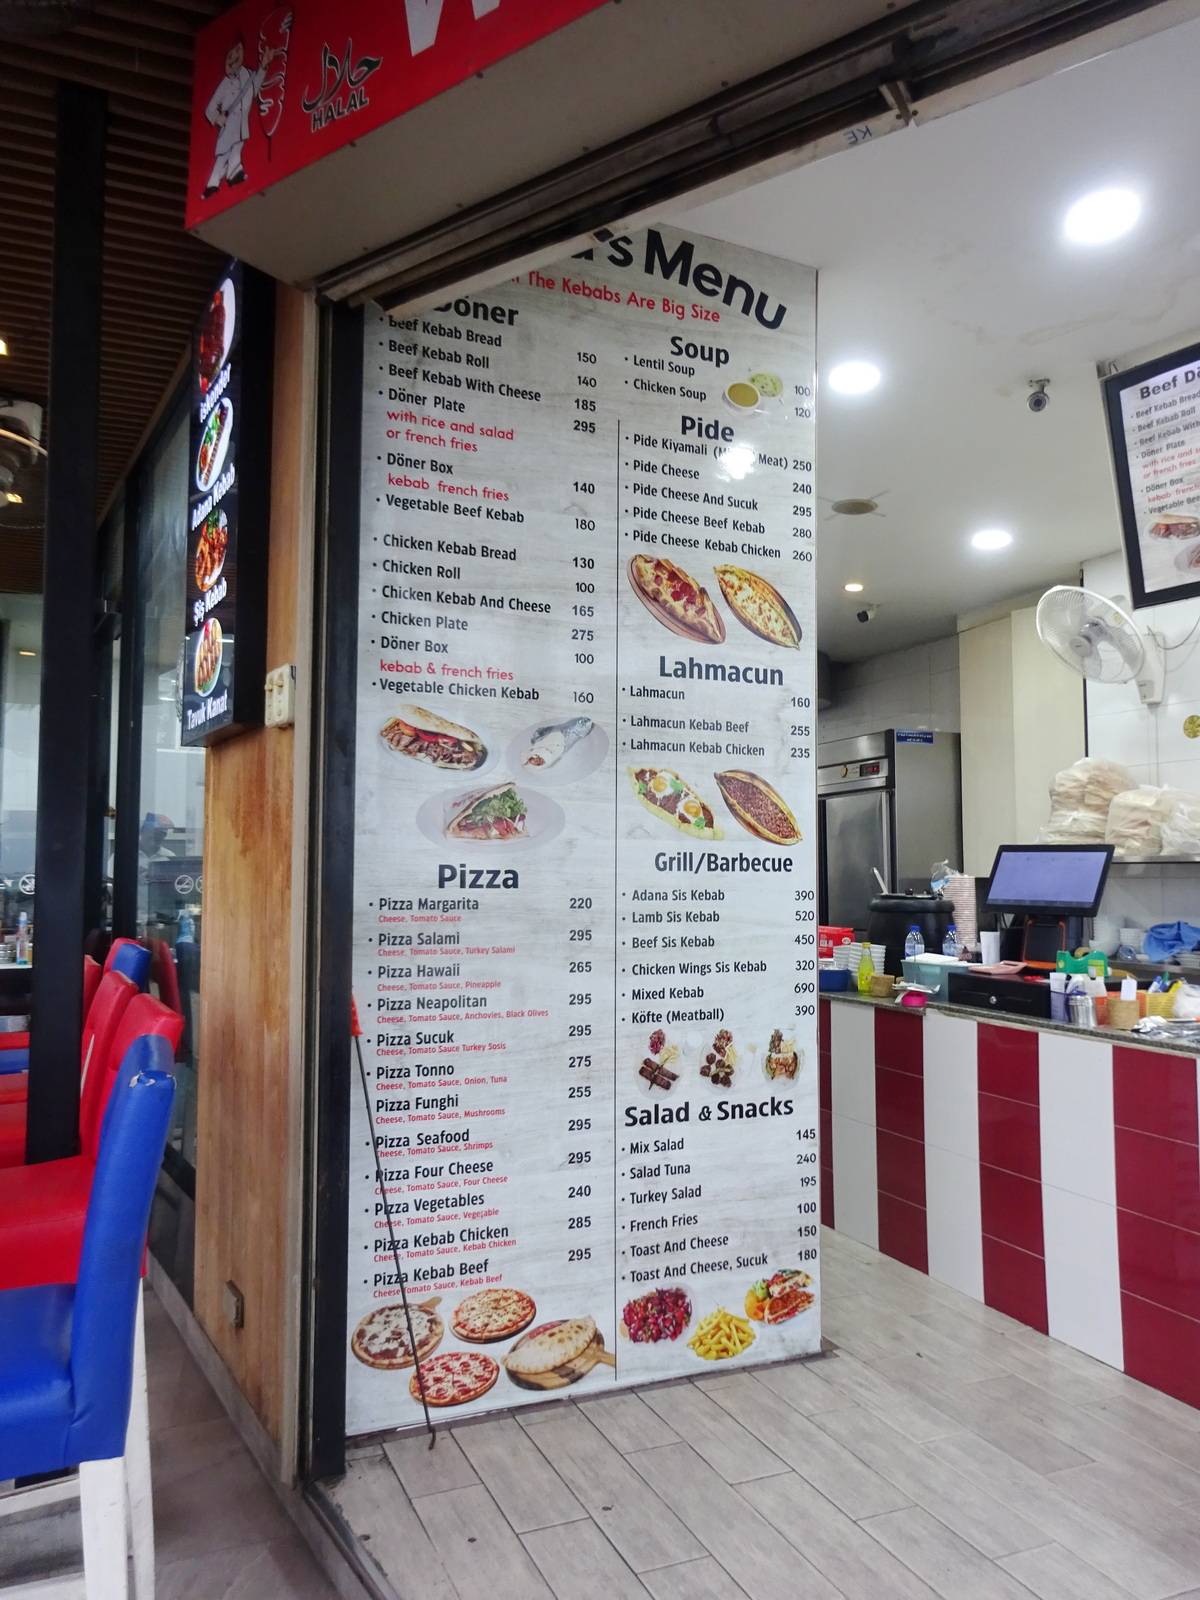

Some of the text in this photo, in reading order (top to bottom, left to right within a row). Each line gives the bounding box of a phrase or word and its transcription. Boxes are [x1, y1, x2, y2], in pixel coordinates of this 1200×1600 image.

[311, 87, 369, 133] HALAL
[644, 229, 787, 329] Menu
[529, 271, 555, 290] The
[563, 278, 621, 303] Kebabs
[627, 292, 655, 310] Are
[662, 298, 685, 320] Big
[691, 305, 720, 322] Size
[422, 322, 462, 339] Kebab
[467, 326, 502, 346] Bread
[389, 340, 489, 368] Beef Kebab Roll
[577, 352, 597, 364] 150
[670, 336, 729, 367] Soup
[634, 355, 695, 377] Lentil Soup
[634, 379, 706, 401] Chicken Soup
[795, 385, 810, 397] 100
[1140, 375, 1178, 400] Beef
[388, 388, 465, 413] Döner Plate
[575, 399, 596, 412] 185
[795, 407, 811, 418] 120
[1136, 406, 1152, 418] Beef
[1154, 399, 1177, 412] Kebab
[387, 411, 514, 440] with rice and salad
[573, 420, 596, 433] 295
[681, 415, 734, 442] Pide
[1138, 420, 1154, 432] Beef
[1156, 413, 1179, 425] Kebab
[634, 434, 657, 447] Pide
[662, 438, 707, 455] Kiyamali
[759, 453, 788, 470] Meat)
[634, 460, 700, 479] Pide Cheese
[793, 460, 811, 472] 250
[793, 483, 811, 494] 240
[386, 494, 524, 523] Vegetable Beef Kebab
[1149, 498, 1184, 514] Vegetable
[575, 518, 595, 531] 180
[633, 530, 781, 558] Pide Cheese Kebab Chicken
[793, 551, 812, 562] 260
[383, 560, 461, 579] Chicken Roll
[206, 577, 227, 612] Kebab
[576, 583, 595, 593] 100
[380, 660, 513, 680] kebab & french fries
[660, 656, 783, 686] Lahmacun
[380, 679, 539, 700] Vegetable Chicken Kebab
[630, 686, 685, 700] Lahmacun
[574, 692, 594, 703] 160
[791, 697, 810, 708] 160
[187, 689, 228, 730] Tavuk Kanat
[631, 716, 749, 733] Lahmacun Kebab Beef
[791, 726, 810, 736] 255
[655, 852, 792, 874] Grill/Barbecue
[438, 864, 519, 889] Pizza
[632, 890, 725, 901] Adana Sis Kebab
[795, 891, 814, 900] 390
[379, 898, 479, 912] Pizza Margarita
[569, 898, 592, 909] 220
[379, 932, 460, 945] Pizza Salami
[569, 930, 592, 941] 295
[632, 961, 767, 976] Chicken Wings Sis Kebab
[795, 961, 814, 970] 320
[632, 987, 704, 1000] Mixed Kebab
[794, 983, 814, 993] 690
[378, 996, 487, 1011] Pizza Neapolitan
[569, 994, 592, 1005] 295
[632, 1008, 724, 1024] Köfte (Meatball)
[795, 1006, 815, 1015] 390
[377, 1031, 454, 1046] Pizza Sucuk
[439, 1045, 459, 1053] Sauce
[462, 1044, 485, 1052] Turkey
[569, 1056, 591, 1068] 275
[377, 1064, 454, 1079] Pizza Tonno
[408, 1081, 436, 1089] Tomato
[438, 1079, 462, 1087] Sauce,
[464, 1077, 488, 1085] Onion,
[491, 1075, 507, 1083] Tuna
[568, 1086, 591, 1098] 255
[377, 1095, 459, 1112] Pizza Funghi
[407, 1114, 435, 1122] Tomato
[438, 1112, 462, 1120] Sauce,
[464, 1109, 505, 1118] Mushrooms
[625, 1097, 794, 1127] Salad & Snacks
[568, 1119, 591, 1130] 295
[796, 1129, 816, 1140] 145
[630, 1138, 684, 1154] Mix Salad
[797, 1153, 816, 1164] 240
[630, 1164, 690, 1179] Salad Tuna
[798, 1202, 816, 1213] 100
[631, 1214, 698, 1232] French Fries
[798, 1249, 817, 1260] 180
[374, 1260, 489, 1287] Pizza Kebab Beef
[631, 1254, 768, 1282] Toast And Cheese, Sucuk
